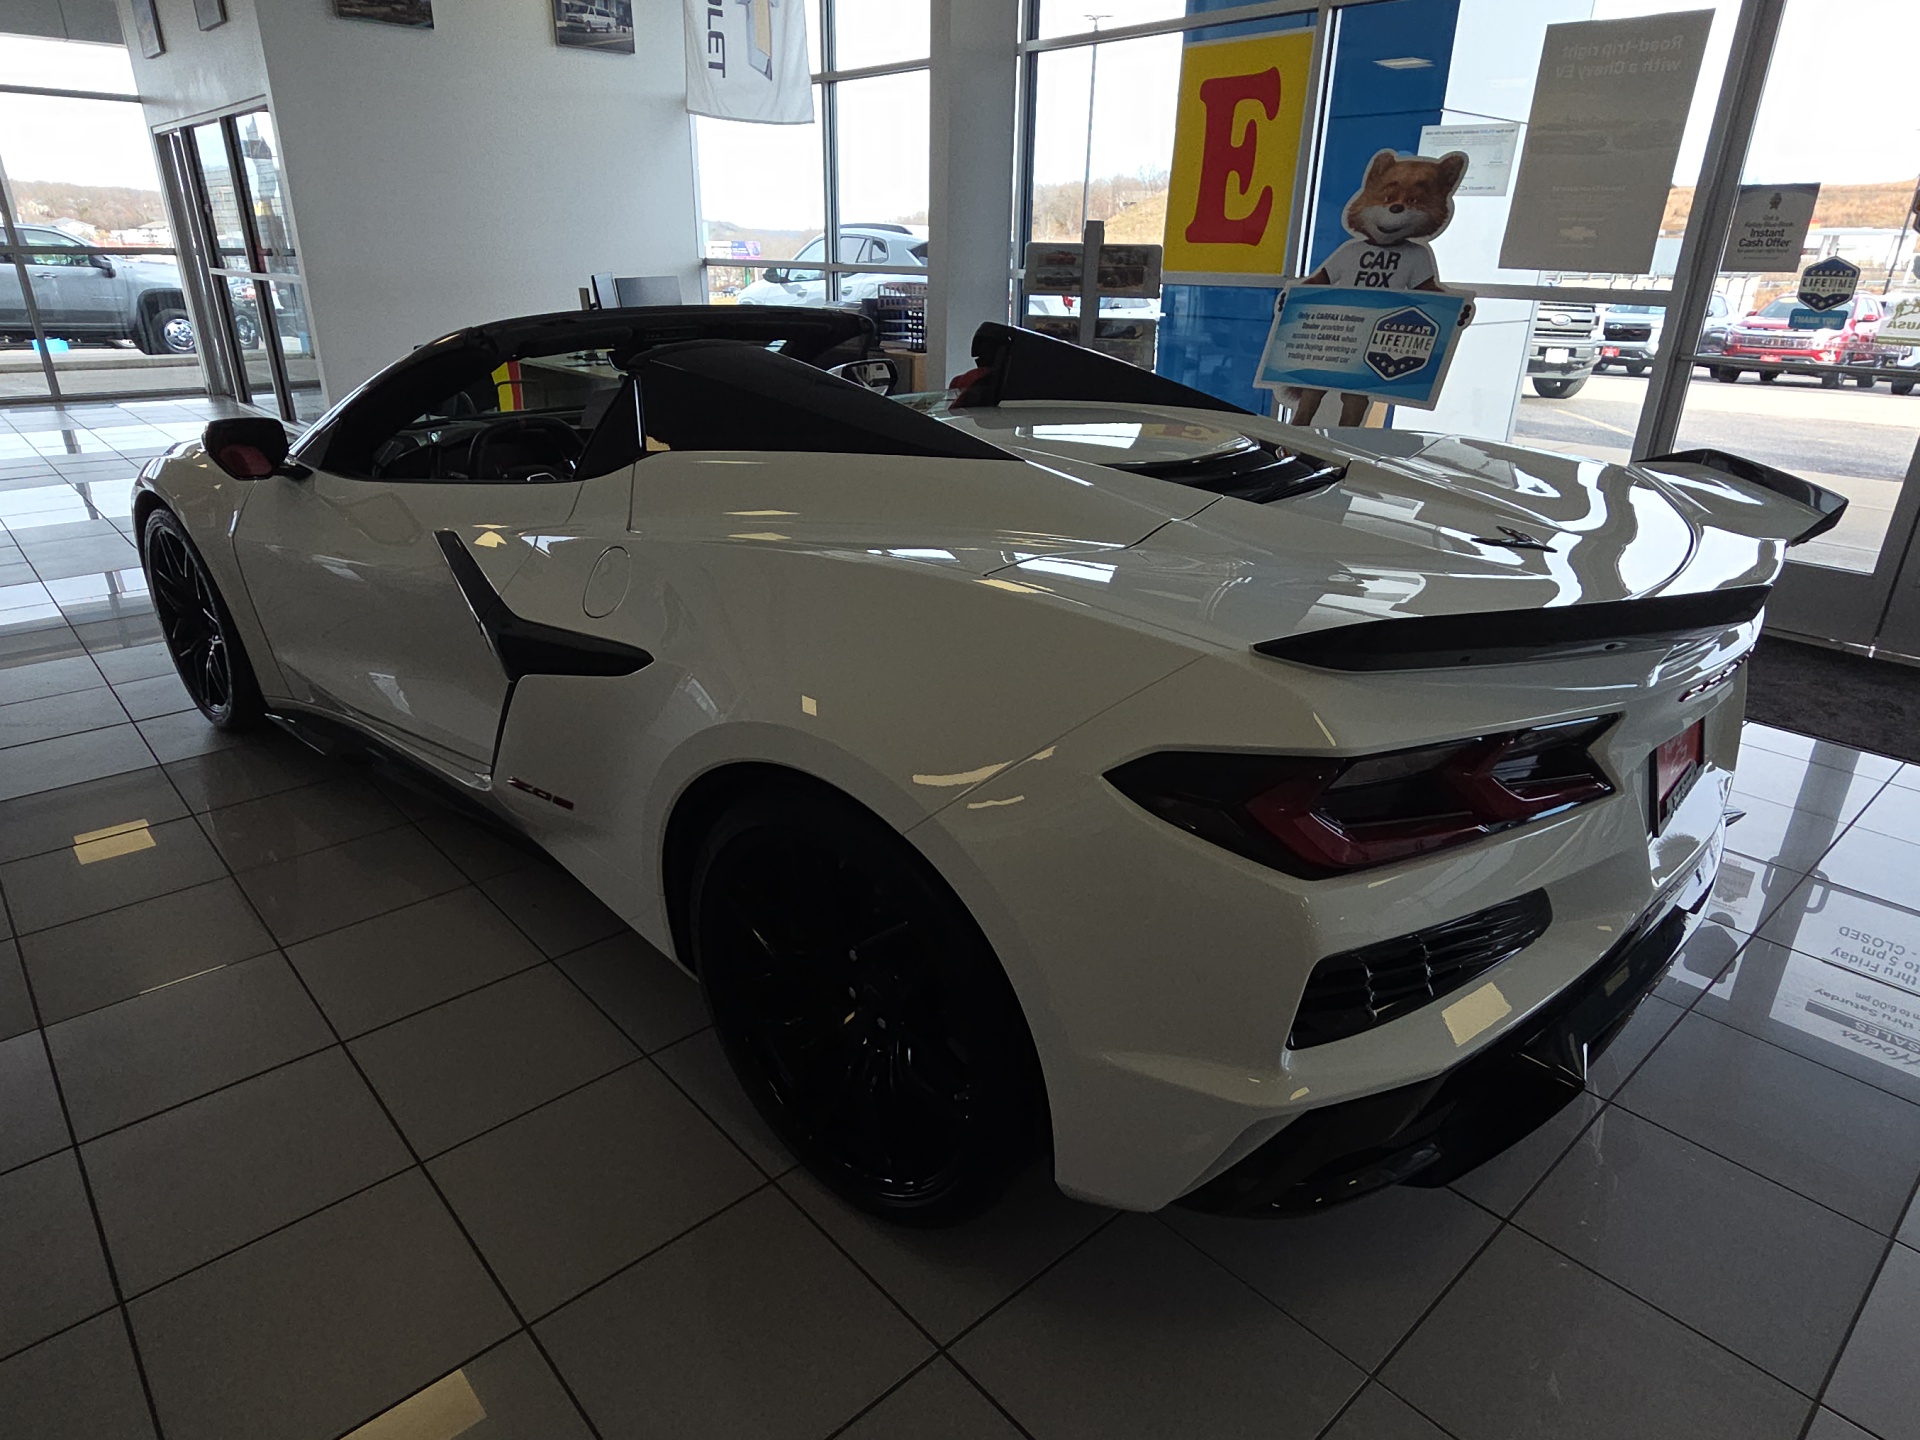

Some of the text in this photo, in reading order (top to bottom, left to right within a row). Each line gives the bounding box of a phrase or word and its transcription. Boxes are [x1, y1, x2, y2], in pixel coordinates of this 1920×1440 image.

[707, 0, 726, 78] LET
[1185, 66, 1281, 247] E
[1750, 228, 1785, 238] Instant
[1738, 237, 1792, 247] Cash Offer
[1360, 251, 1401, 270] CAR
[1354, 271, 1394, 288] FOX
[1802, 278, 1854, 289] LIFETIME
[1316, 312, 1339, 321] CARFAX
[1340, 314, 1365, 323] Lifetime
[1794, 315, 1819, 324] THANK
[1383, 323, 1431, 335] CARFAX
[1317, 333, 1341, 341] CARFAX
[1372, 332, 1433, 351] LIFETIME
[1381, 346, 1417, 355] DEALER
[1839, 925, 1906, 956] CLOSED
[1861, 945, 1887, 960] pm
[1831, 947, 1918, 986] thru Friday
[1889, 956, 1899, 967] 5
[1855, 992, 1872, 1003] pm
[1814, 988, 1915, 1029] thru Saturday
[1872, 999, 1898, 1013] 6:00
[1899, 1008, 1911, 1017] to
